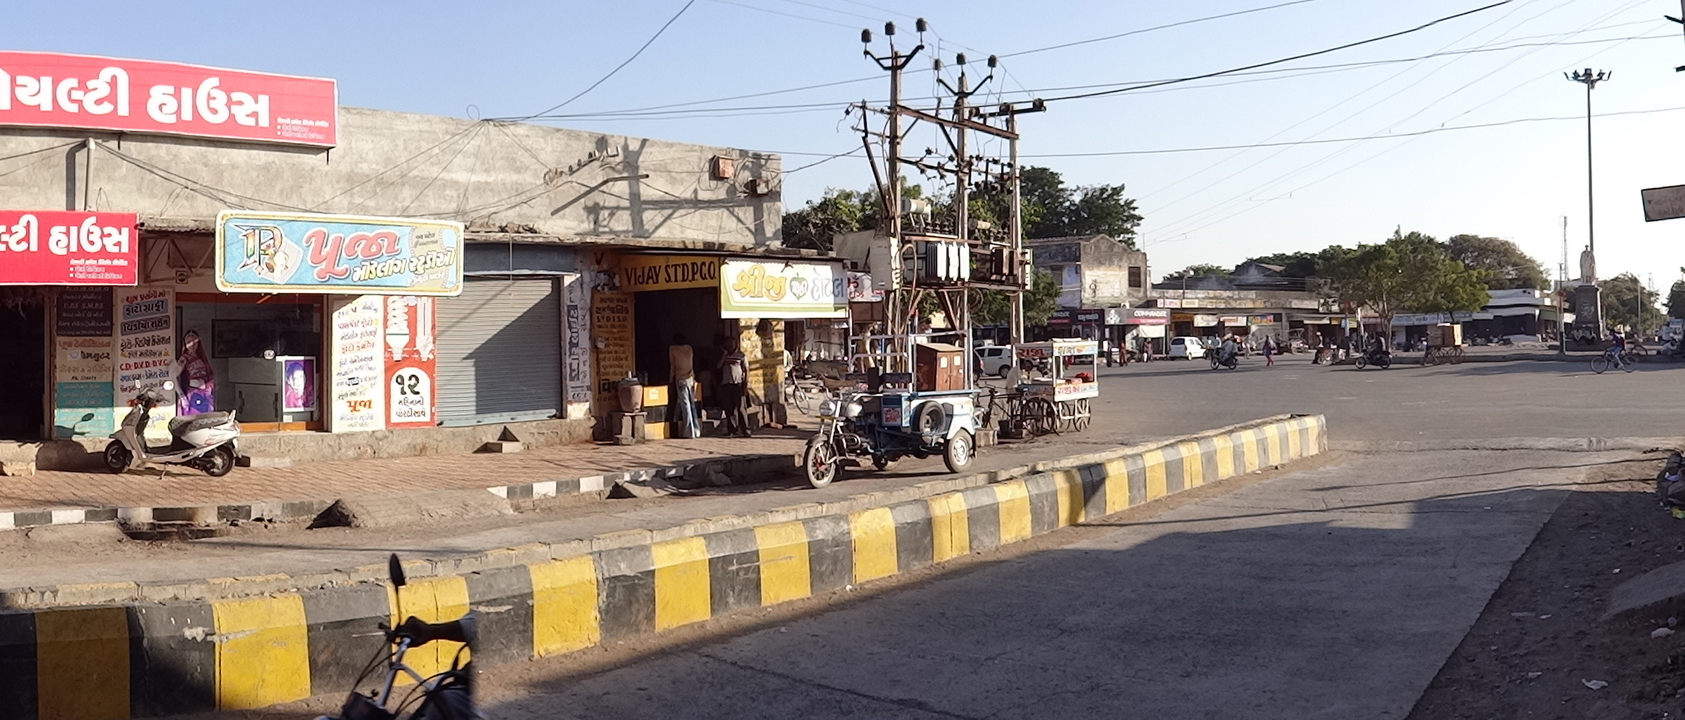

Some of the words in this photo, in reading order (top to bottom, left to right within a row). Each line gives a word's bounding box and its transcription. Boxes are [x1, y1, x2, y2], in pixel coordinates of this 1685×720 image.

[147, 77, 270, 128] હાઉસ
[48, 216, 129, 256] હાઉસ
[304, 228, 401, 281] પૂજા
[624, 265, 662, 286] VIJAY
[732, 264, 788, 302] શ્રીજી
[395, 374, 421, 396] ૧૨
